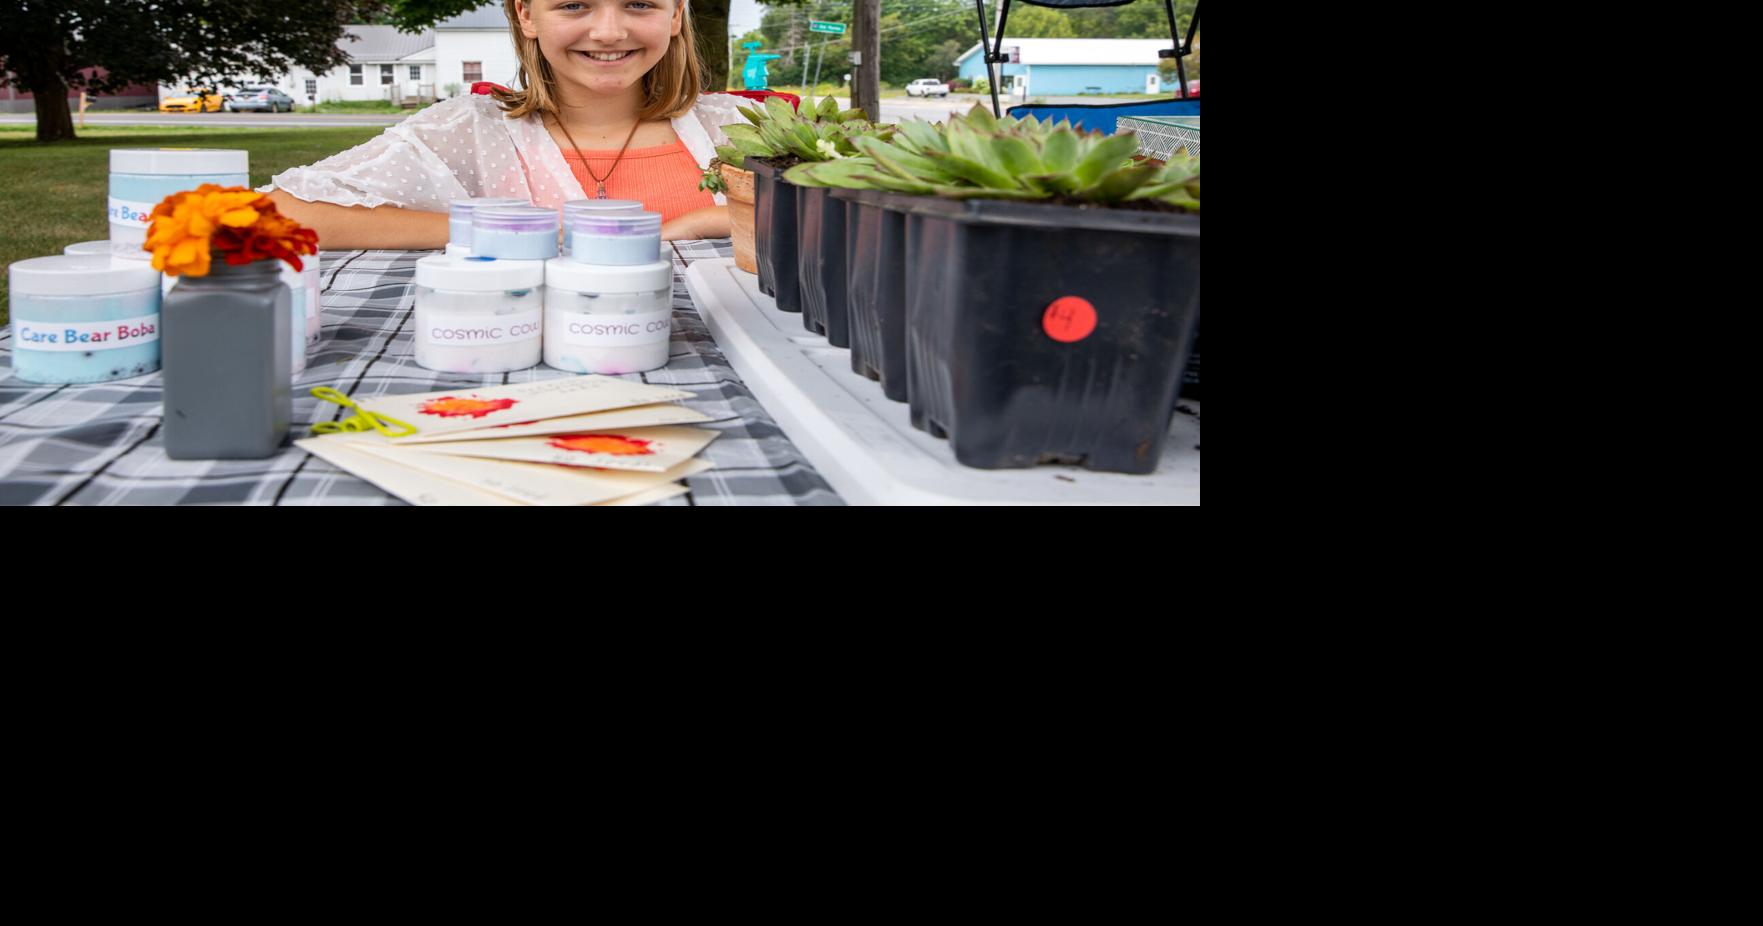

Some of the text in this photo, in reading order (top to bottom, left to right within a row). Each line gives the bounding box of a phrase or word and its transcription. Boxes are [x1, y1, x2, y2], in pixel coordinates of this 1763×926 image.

[21, 323, 156, 343] Care Bear Boba
